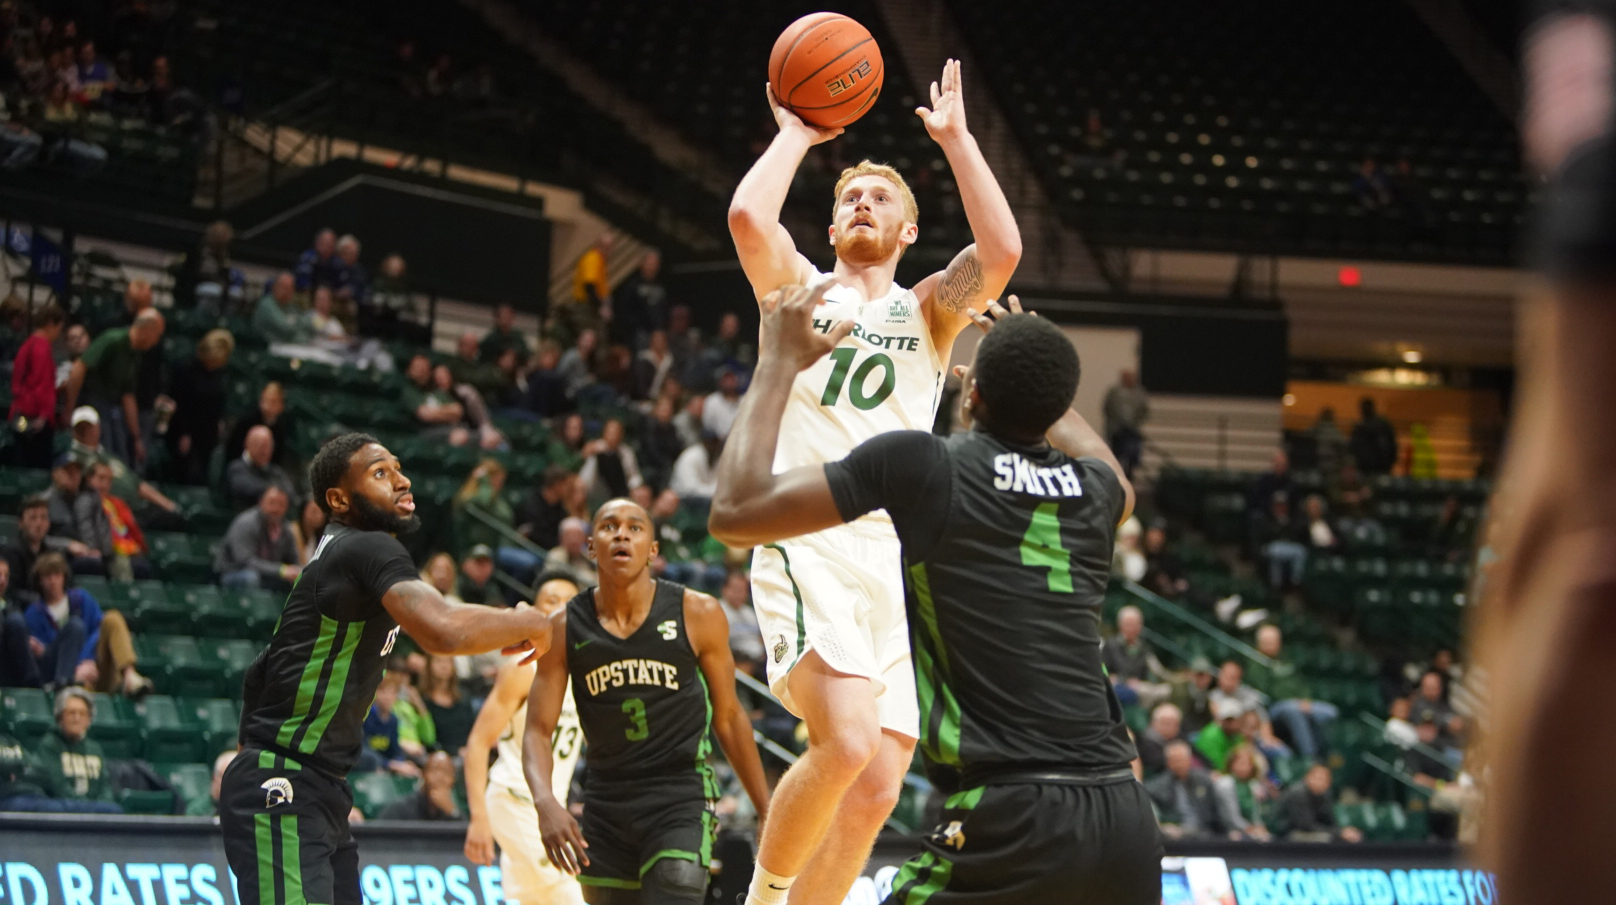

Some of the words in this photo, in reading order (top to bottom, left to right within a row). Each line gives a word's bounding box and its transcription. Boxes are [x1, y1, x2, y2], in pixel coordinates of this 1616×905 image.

[826, 59, 872, 98] ELITE
[812, 318, 920, 352] HRLOTTE
[820, 347, 896, 411] 10
[993, 452, 1083, 497] SMITH
[1019, 502, 1075, 593] 4
[585, 658, 679, 696] UPSTATE
[621, 697, 650, 741] 3
[0, 861, 49, 905] D
[57, 862, 226, 905] RATES
[359, 864, 478, 905] 9ERS
[1230, 867, 1395, 905] DISCOUNTED
[1461, 869, 1499, 905] FO
